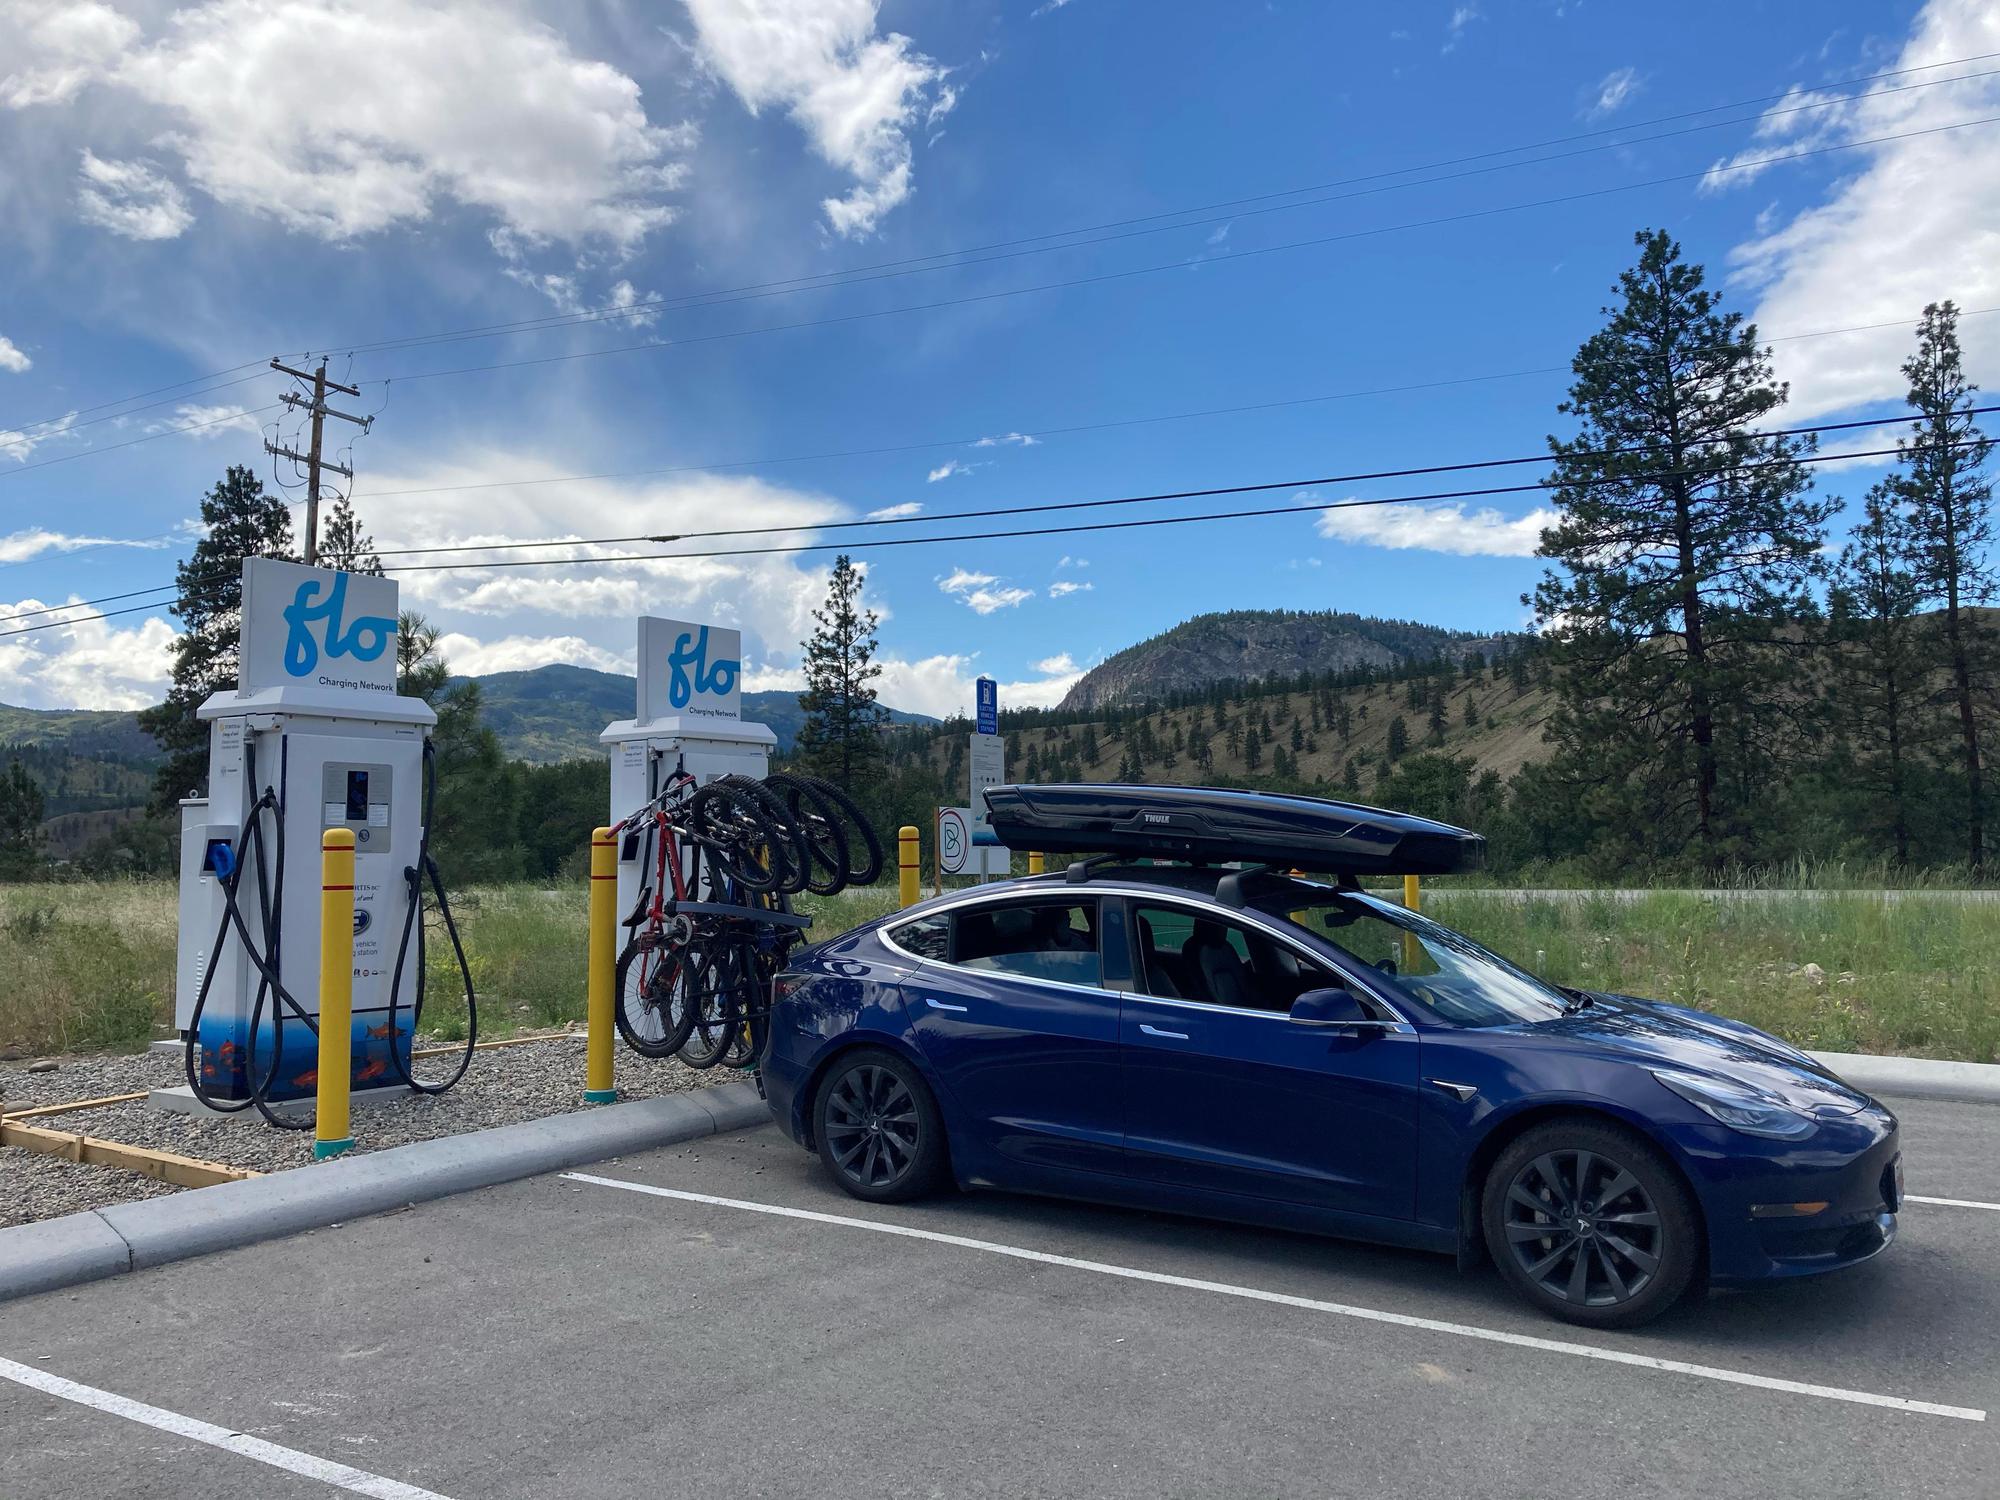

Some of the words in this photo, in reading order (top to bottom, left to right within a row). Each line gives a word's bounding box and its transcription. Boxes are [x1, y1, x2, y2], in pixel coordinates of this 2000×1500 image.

[283, 572, 398, 677] flo
[668, 625, 741, 709] flo
[318, 676, 358, 690] Charging
[359, 680, 394, 692] Network
[689, 706, 715, 717] Charging
[715, 709, 737, 717] Network
[1144, 814, 1170, 824] THULE
